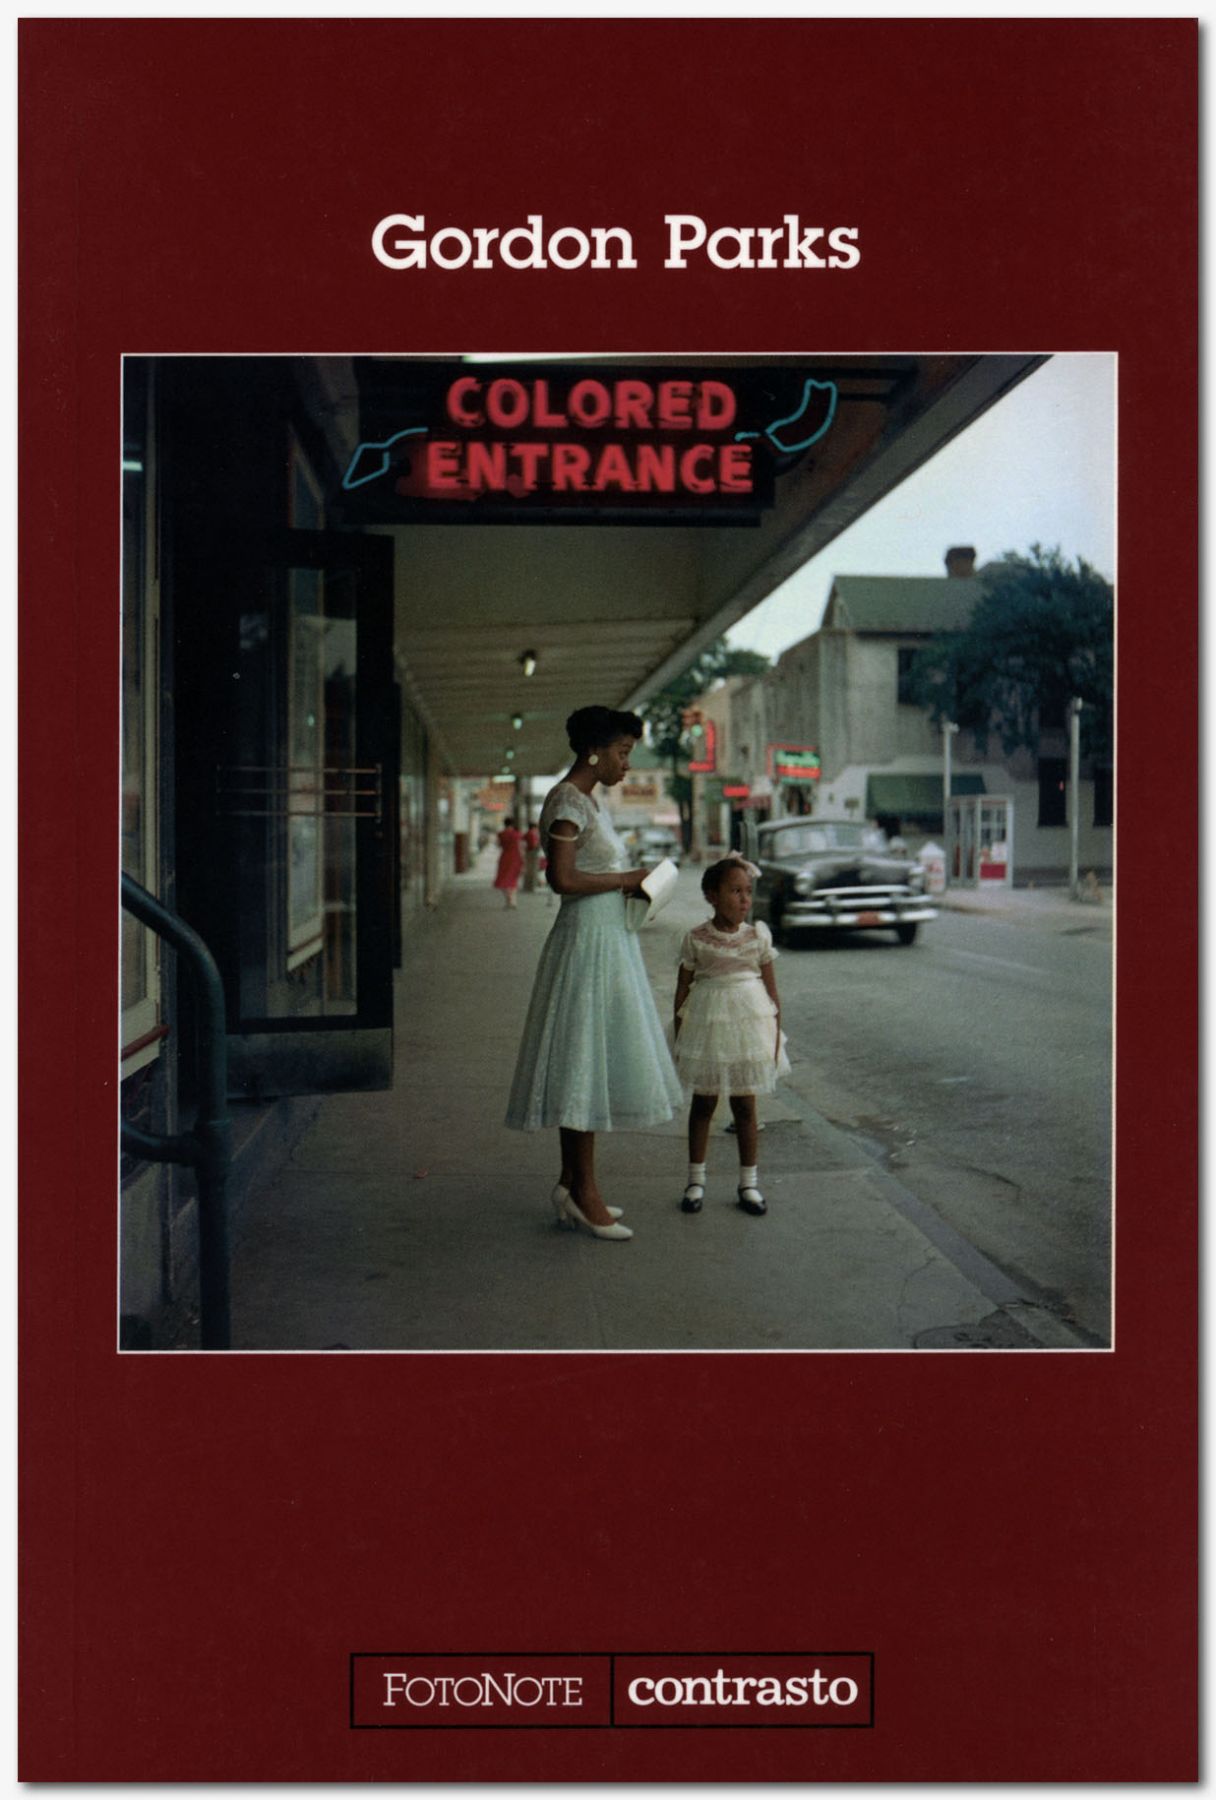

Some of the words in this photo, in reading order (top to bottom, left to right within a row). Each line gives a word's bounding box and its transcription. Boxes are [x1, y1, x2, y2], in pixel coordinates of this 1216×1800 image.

[371, 213, 638, 270] Gordon
[664, 214, 861, 270] Parks
[446, 377, 736, 430] COLORED
[426, 442, 753, 493] ENTRANCE
[627, 1668, 859, 1706] contrasto
